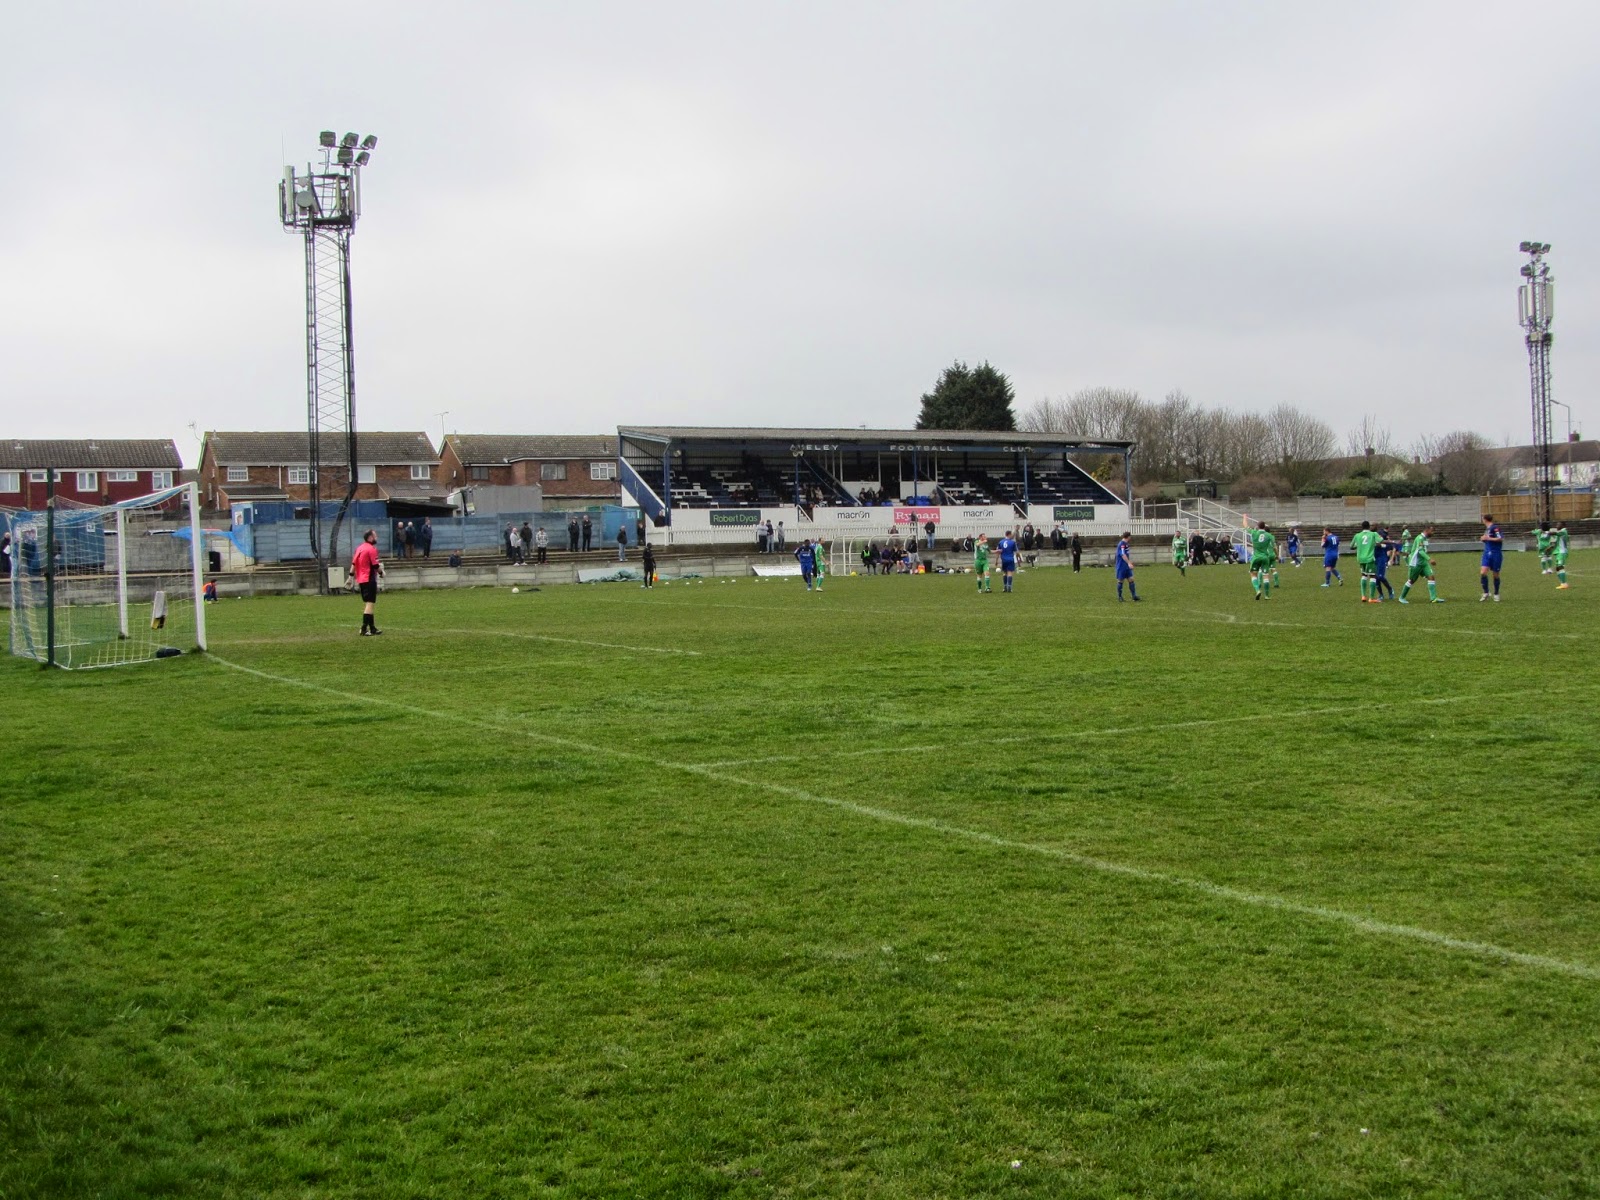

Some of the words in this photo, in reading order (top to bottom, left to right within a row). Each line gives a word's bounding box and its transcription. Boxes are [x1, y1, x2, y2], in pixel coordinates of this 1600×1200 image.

[890, 444, 954, 452] FOOTBALL
[837, 510, 870, 519] macron
[963, 510, 994, 518] macron
[1055, 510, 1076, 518] Robert
[1077, 510, 1092, 519] Dyas
[713, 514, 738, 523] Robert
[740, 514, 758, 524] Dyas
[1361, 535, 1369, 544] 2
[1003, 540, 1008, 549] 6
